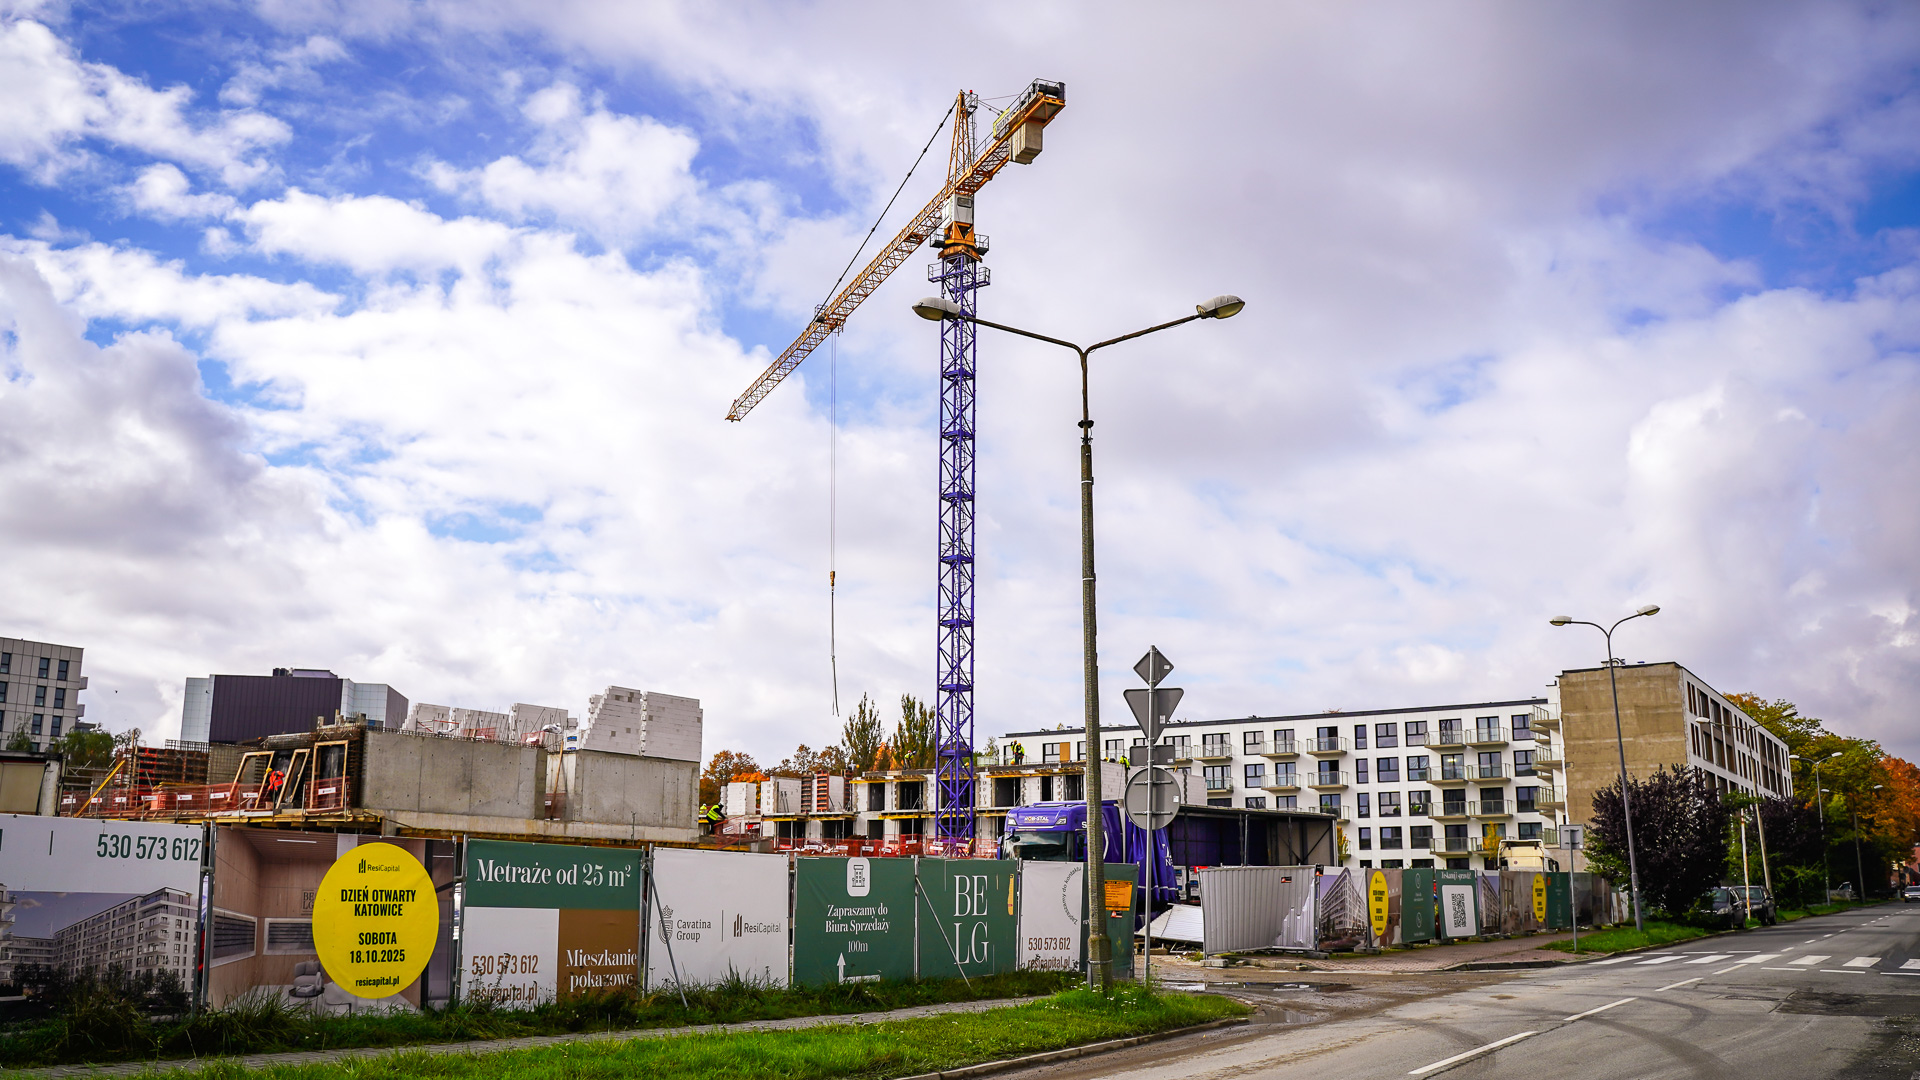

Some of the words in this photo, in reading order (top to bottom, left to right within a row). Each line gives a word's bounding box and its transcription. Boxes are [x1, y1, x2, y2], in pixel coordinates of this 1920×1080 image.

[97, 834, 131, 858] 530
[136, 836, 167, 860] 573
[172, 838, 199, 861] 612
[367, 864, 400, 872] ResiCapital
[476, 859, 551, 884] Metraże
[556, 864, 577, 885] od
[582, 863, 603, 886] 25
[341, 886, 368, 902] DZIEŃ
[372, 890, 416, 902] OTWARTY
[953, 875, 987, 916] BE
[354, 904, 403, 916] KATOWICE
[827, 905, 876, 920] Zapraszamy
[878, 902, 888, 915] do
[677, 919, 711, 929] Cavatina
[744, 922, 781, 935] ResiCapital
[825, 920, 848, 933] Biura
[850, 918, 890, 935] Sprzedaży
[358, 932, 397, 945] SOBOTA
[676, 931, 701, 942] Group
[953, 921, 989, 964] LG
[1028, 937, 1042, 950] 530
[1044, 937, 1057, 950] 573
[1059, 937, 1070, 950] 612
[848, 940, 868, 953] 100m
[350, 949, 405, 963] 18.10.2025
[566, 948, 637, 967] Mieszkanie
[472, 955, 494, 975] 530
[497, 955, 517, 974] 573
[520, 955, 538, 974] 612
[356, 976, 400, 987] resicapital.pl
